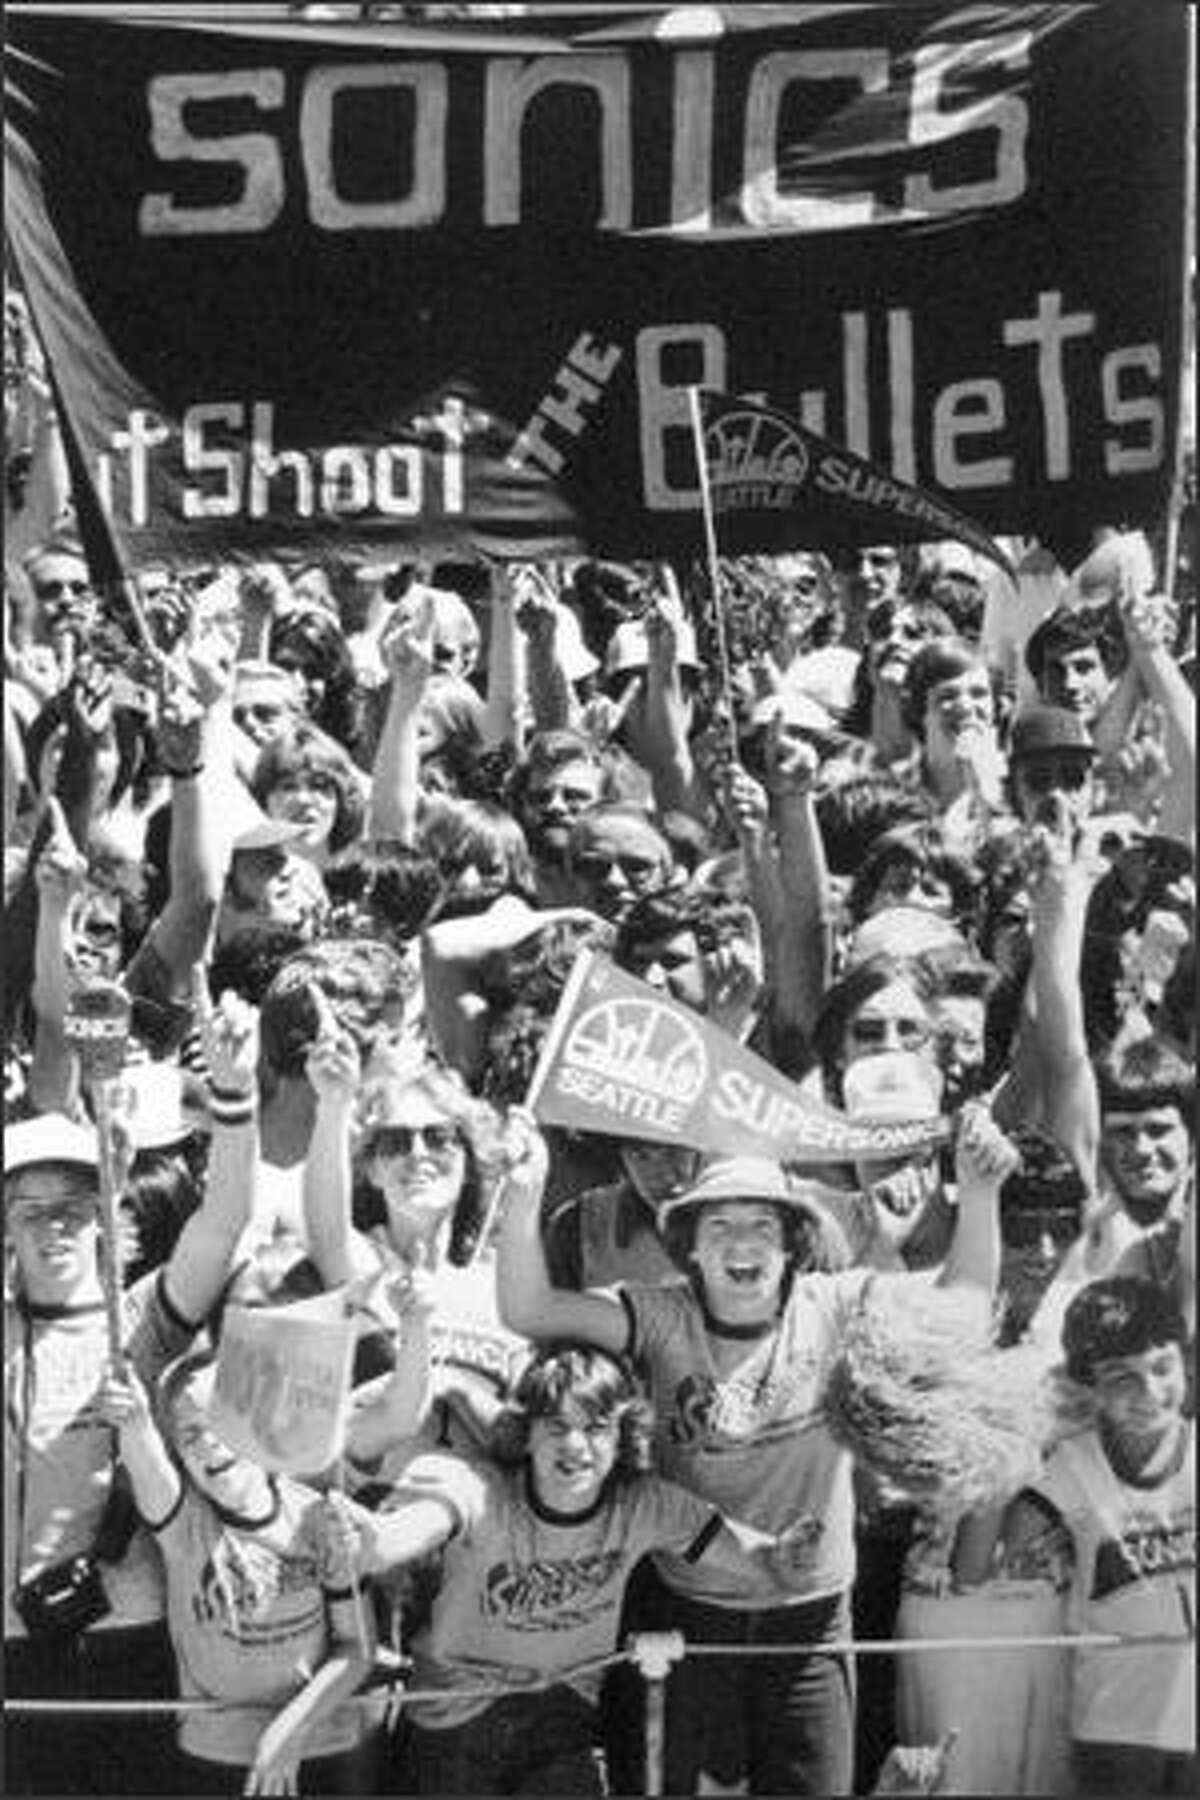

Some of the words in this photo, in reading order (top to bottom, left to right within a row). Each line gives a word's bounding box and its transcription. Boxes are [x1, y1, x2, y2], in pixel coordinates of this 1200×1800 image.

[183, 398, 490, 518] Shoot
[505, 331, 623, 476] THE
[636, 291, 1165, 510] Bllets
